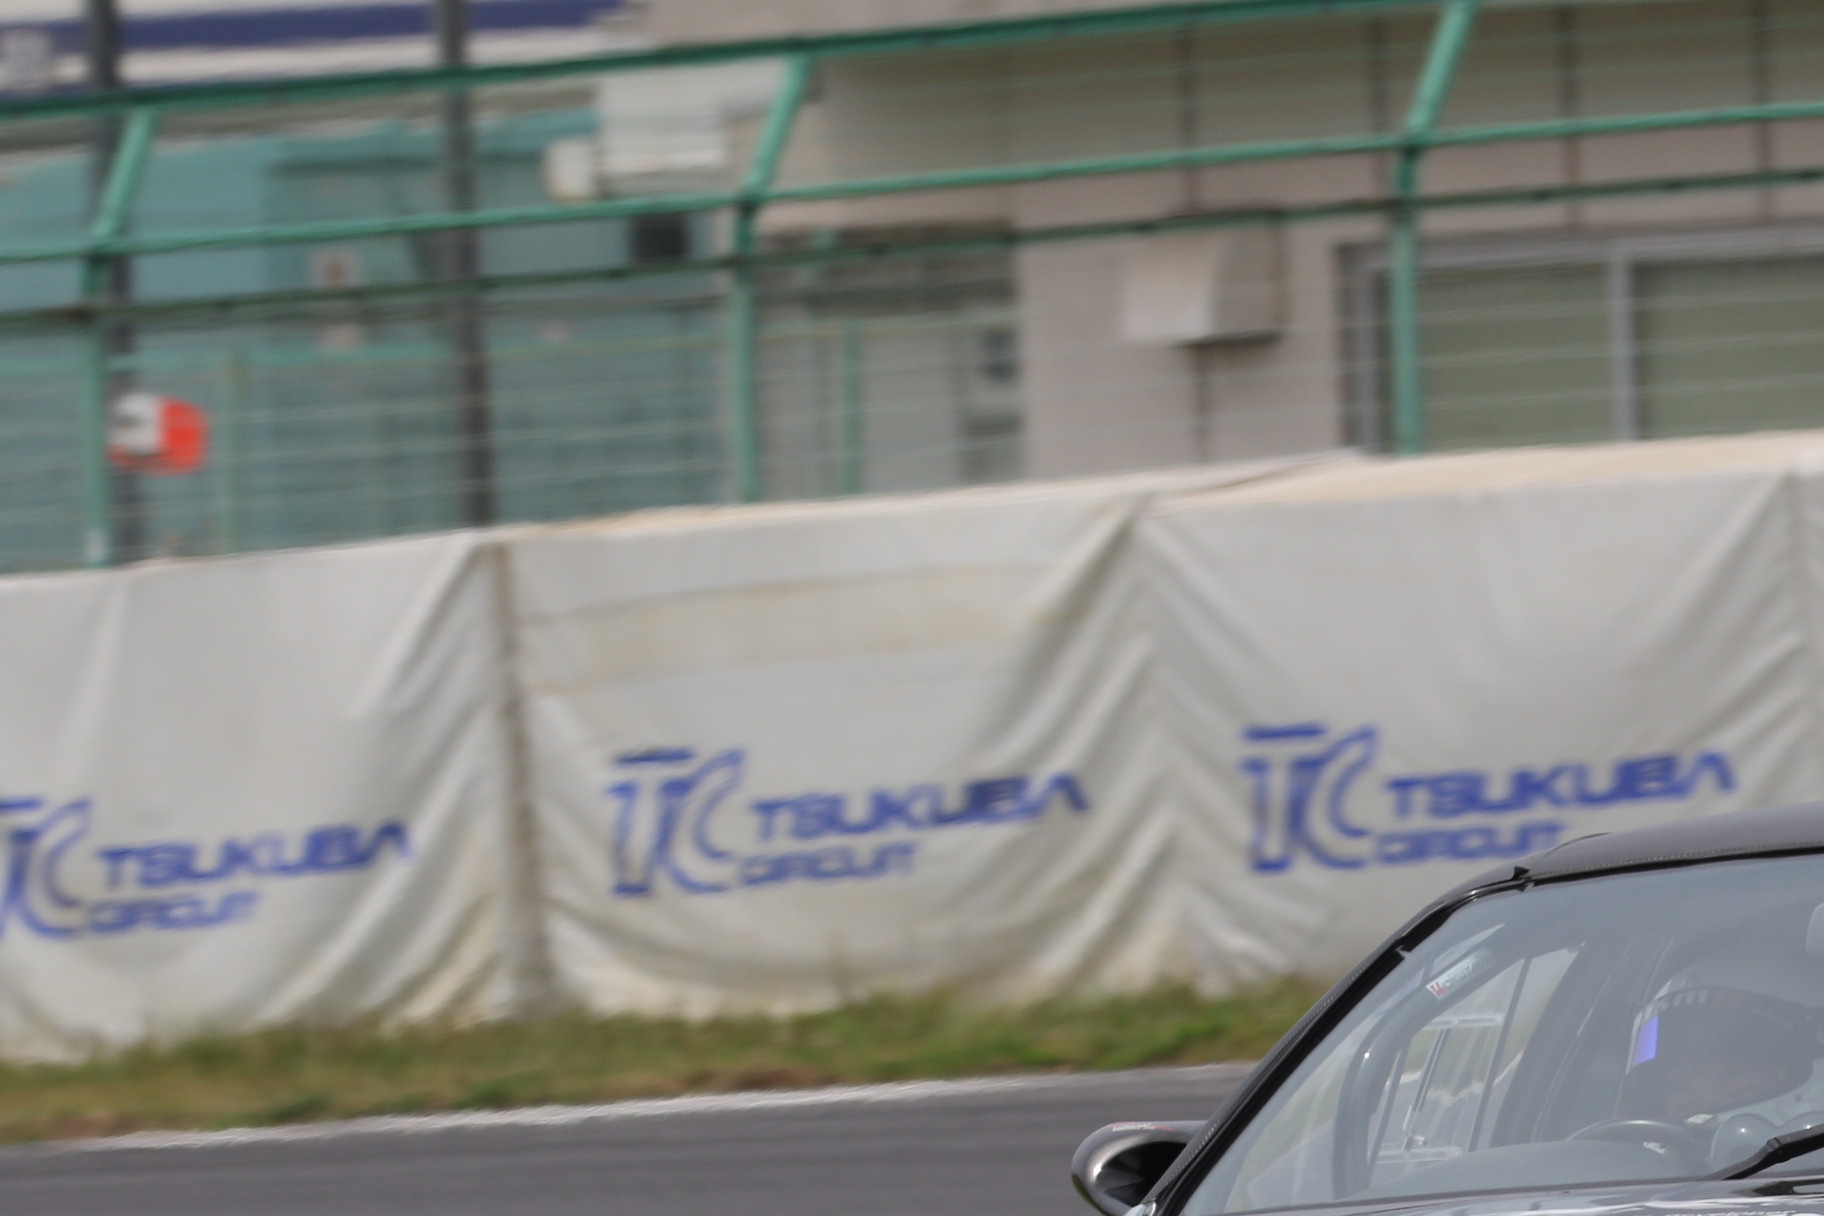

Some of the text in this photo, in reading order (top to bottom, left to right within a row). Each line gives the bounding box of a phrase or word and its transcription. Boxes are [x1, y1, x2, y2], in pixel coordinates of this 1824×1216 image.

[750, 769, 1092, 842] TSUKUBA
[1385, 750, 1739, 818] TSUKUBA
[97, 821, 412, 890] TSUKUBA
